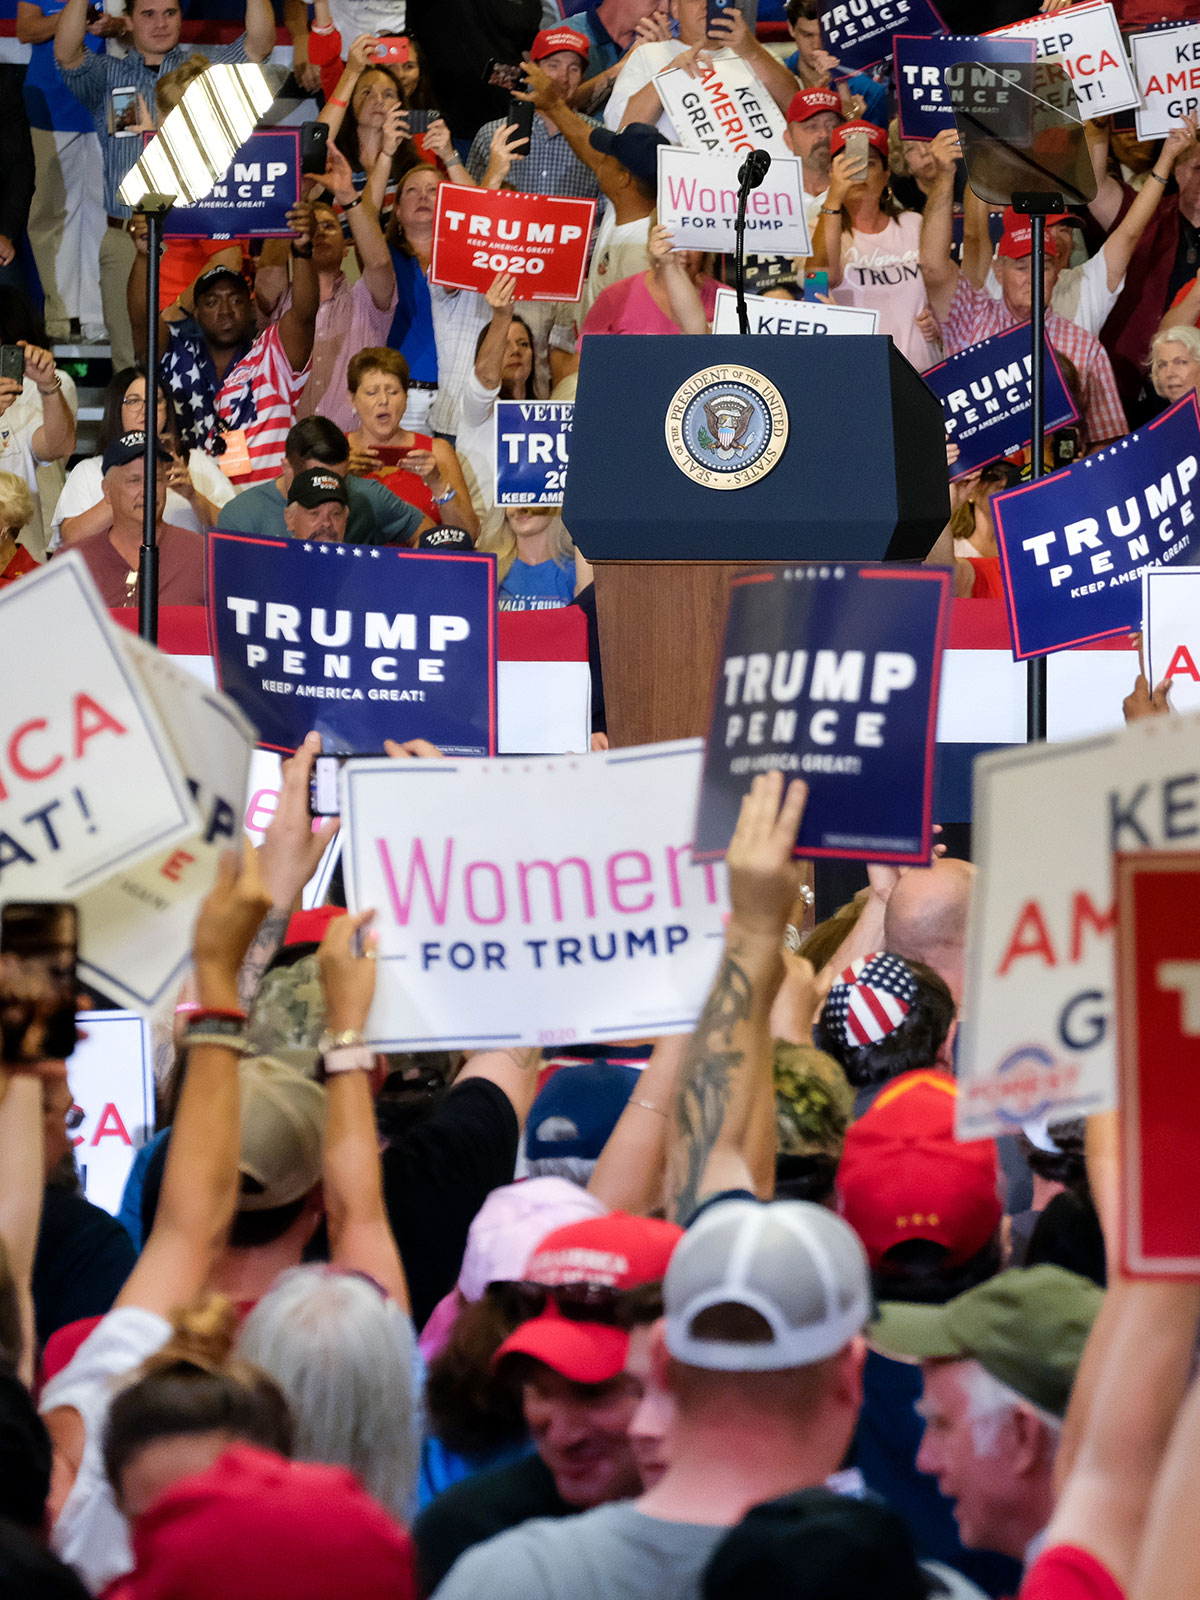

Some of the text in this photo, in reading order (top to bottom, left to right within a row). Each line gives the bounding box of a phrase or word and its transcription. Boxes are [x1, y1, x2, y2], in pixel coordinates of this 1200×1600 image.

[821, 0, 894, 31] TRU
[829, 0, 911, 44] PENCE
[902, 65, 1023, 88] TRUMP
[1035, 49, 1119, 89] ERICA
[700, 68, 755, 153] AMERIC
[735, 86, 774, 140] KEEP
[912, 88, 1010, 104] PENCE
[681, 92, 724, 152] GREA
[198, 201, 235, 209] AMERICA
[213, 185, 276, 198] NCE
[668, 176, 794, 217] Women
[445, 209, 583, 245] TRUMP
[681, 217, 784, 231] FOR TUMP
[467, 238, 488, 247] KEEP
[488, 242, 524, 253] AMERICA
[472, 251, 545, 275] 2020
[853, 264, 921, 286] TRUM
[757, 315, 829, 335] KEEP
[940, 353, 1032, 413] RUM
[519, 404, 574, 421] VETE
[671, 368, 785, 484] SEAL OF THE PRESIDENT OF THE UNITED STATES
[958, 399, 1032, 440] KEEP AMERICA GREA
[501, 433, 569, 464] TRU
[501, 492, 537, 503] KEEP
[1022, 455, 1198, 566] TRUMP
[1050, 500, 1195, 587] PENCE
[1070, 580, 1106, 599] KEEP
[1109, 557, 1163, 588] AMERICA
[1162, 534, 1190, 563] GREAT!
[227, 596, 471, 651] TRUMP
[246, 644, 445, 683] PENCE
[724, 649, 917, 707] TRUMP
[262, 679, 425, 702] KEEP AMERICA GREAT!
[724, 708, 887, 748] PENCE
[376, 835, 719, 928] Women
[421, 924, 689, 972] FOR TRUMP
